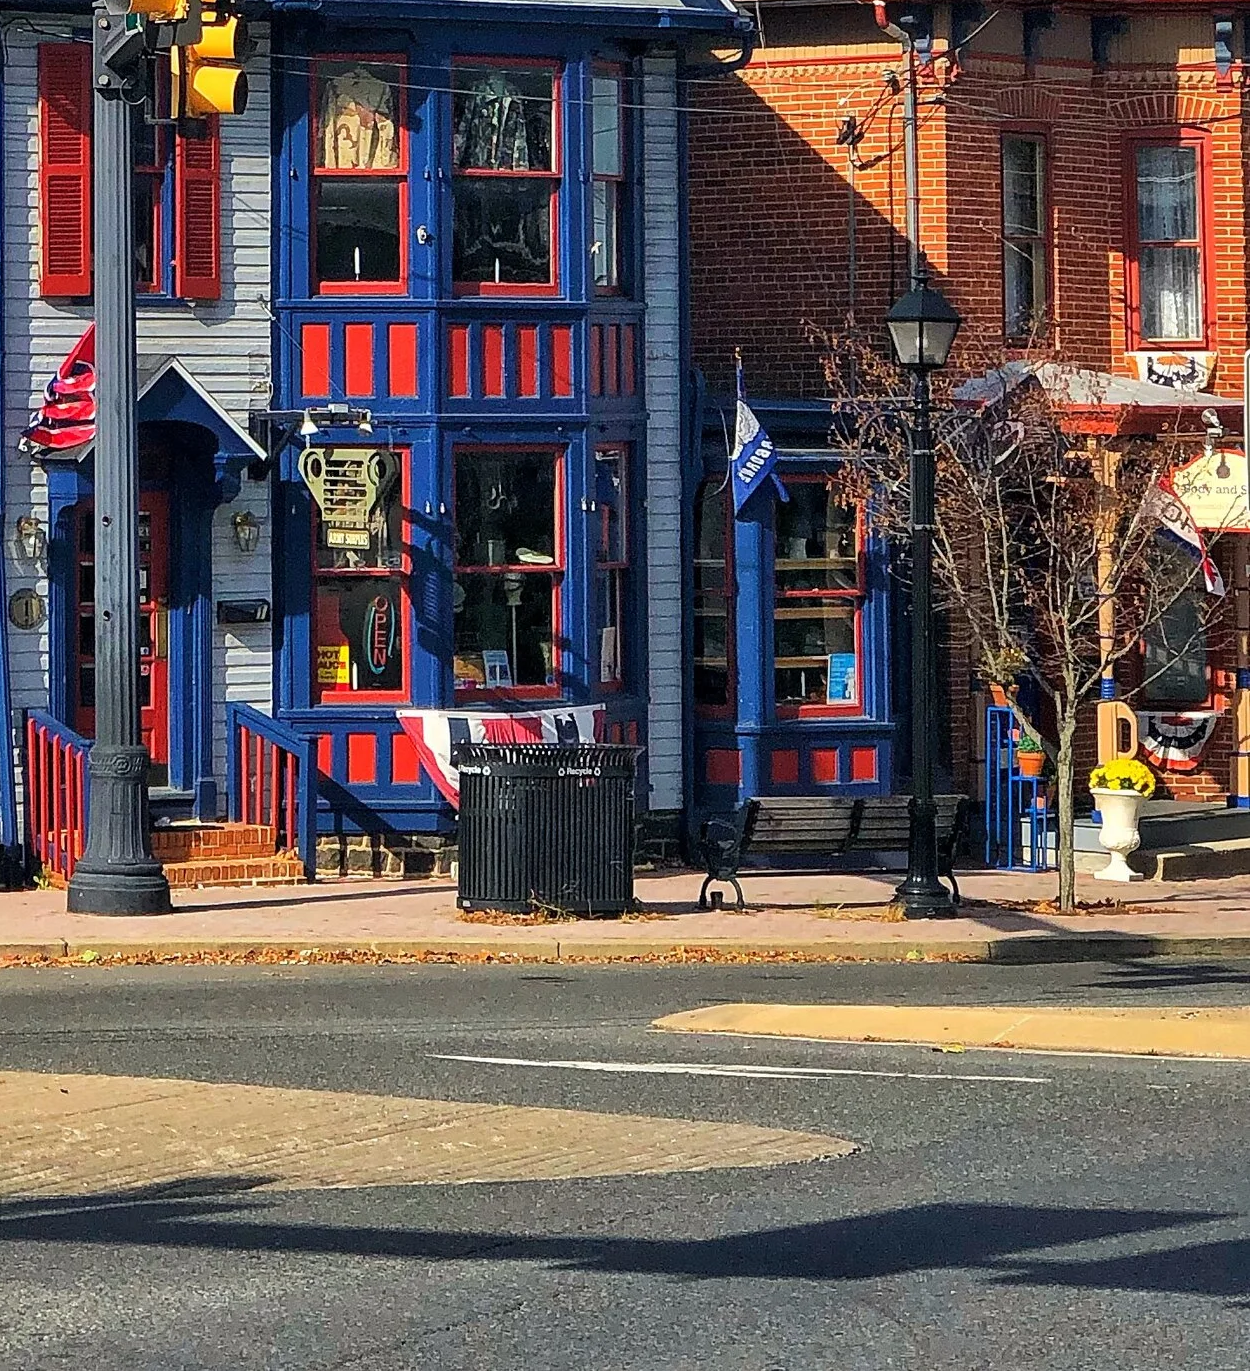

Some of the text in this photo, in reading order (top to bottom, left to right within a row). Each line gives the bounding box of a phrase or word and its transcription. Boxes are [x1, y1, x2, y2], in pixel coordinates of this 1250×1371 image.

[1182, 484, 1212, 496] Body
[1216, 485, 1237, 494] and
[373, 595, 388, 665] OPEN
[566, 767, 593, 776] Recycle
